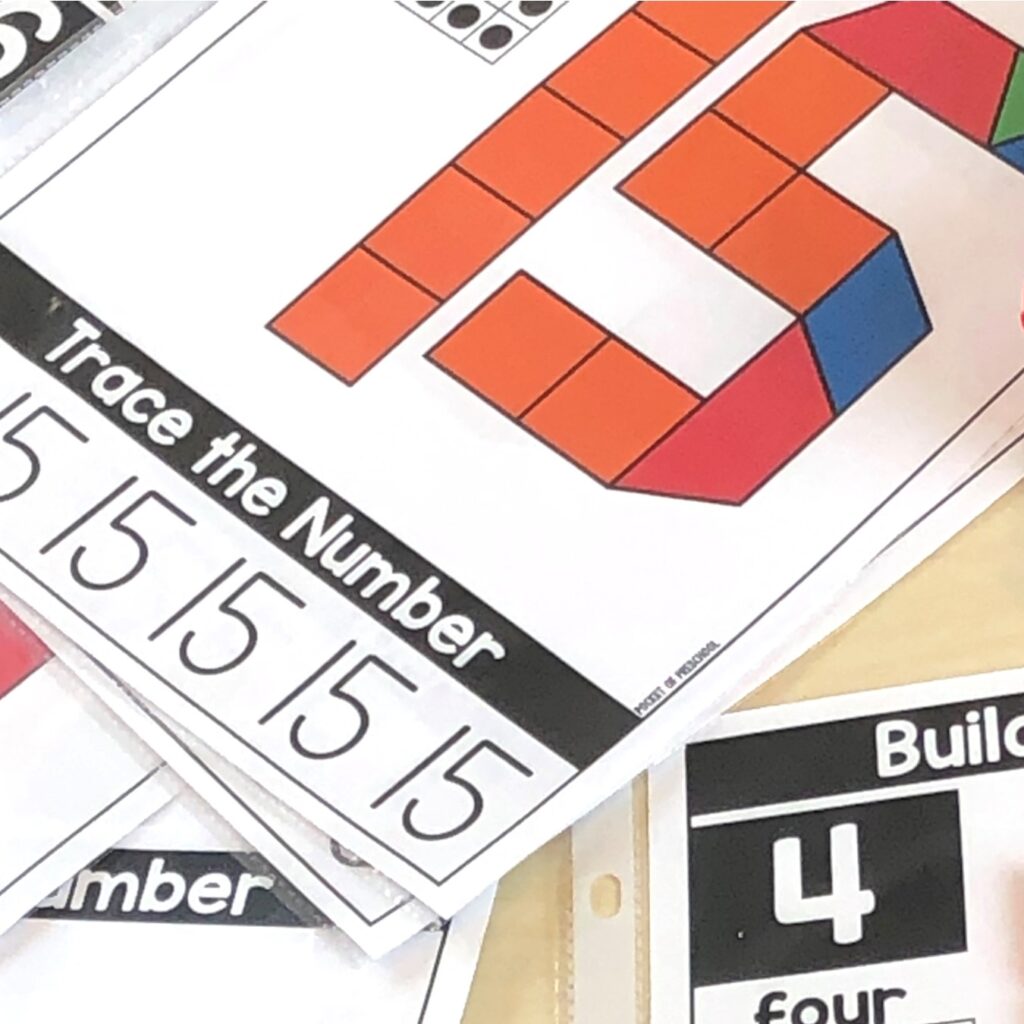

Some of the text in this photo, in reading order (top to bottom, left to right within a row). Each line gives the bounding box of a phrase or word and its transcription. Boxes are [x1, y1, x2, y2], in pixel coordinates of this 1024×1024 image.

[44, 318, 506, 669] Trace the Number
[40, 475, 197, 591] 15
[148, 557, 307, 675] 15
[258, 639, 418, 760] 15
[370, 725, 534, 842] 15
[38, 857, 275, 916] mber
[772, 822, 876, 945] 4
